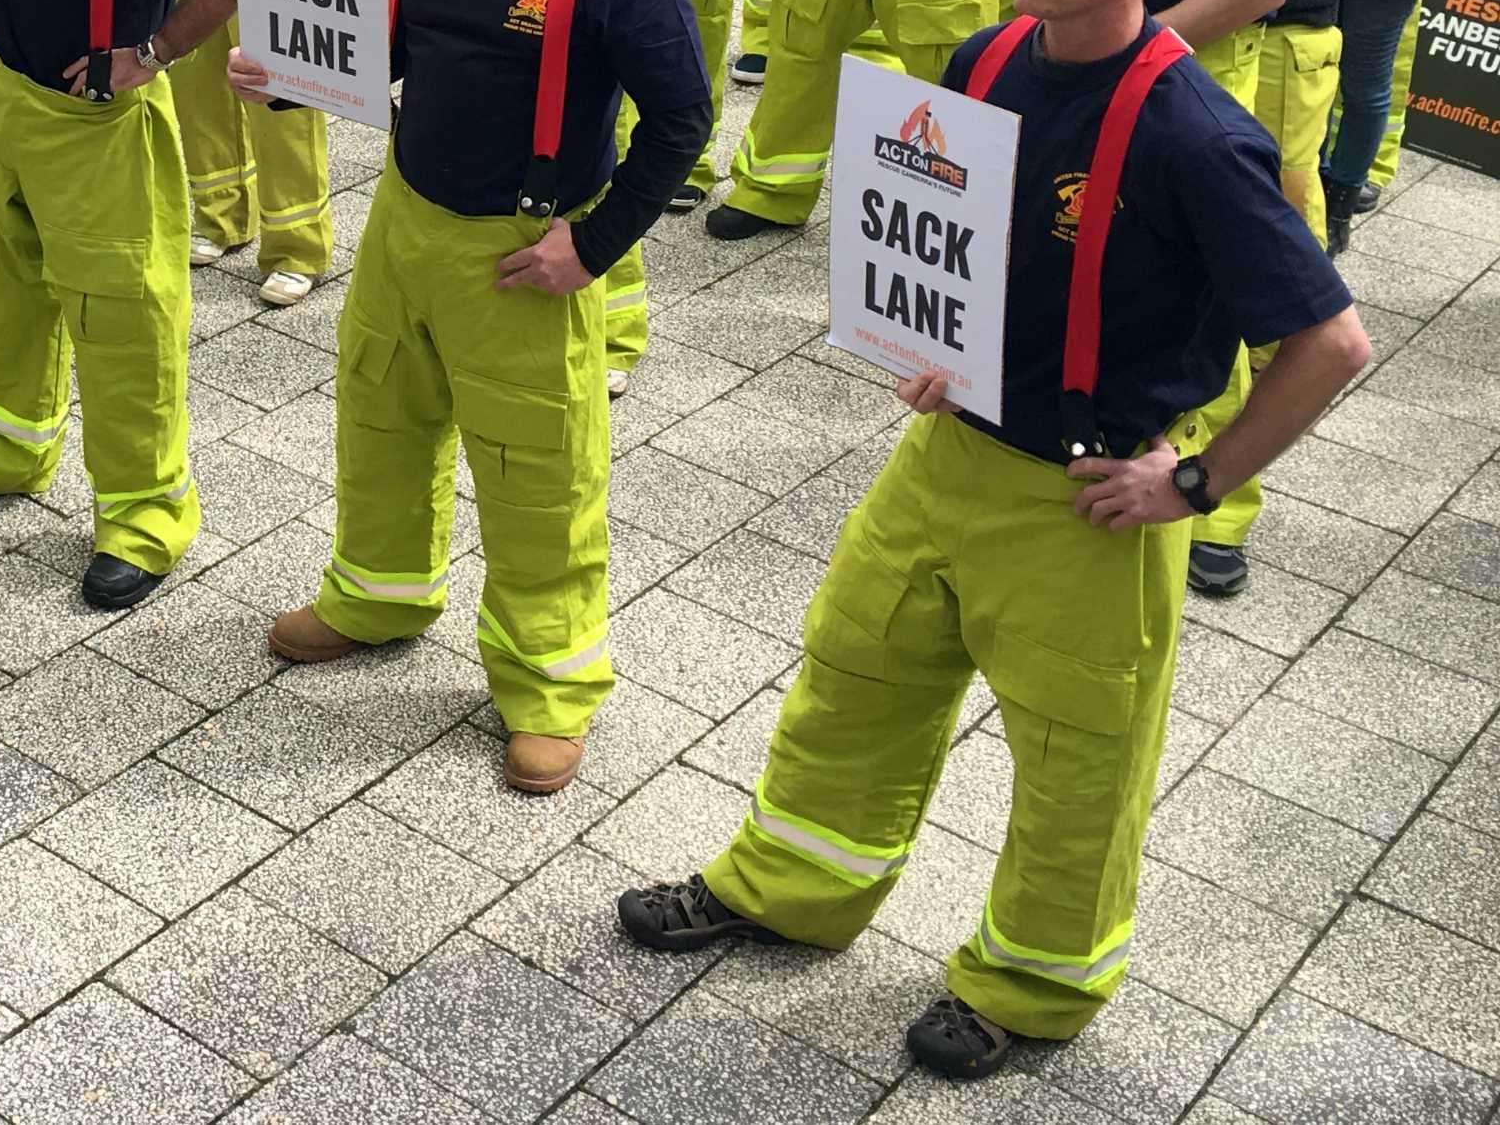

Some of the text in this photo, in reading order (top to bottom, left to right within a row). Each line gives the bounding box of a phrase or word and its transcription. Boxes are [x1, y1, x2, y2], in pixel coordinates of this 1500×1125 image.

[269, 11, 357, 76] LANE
[877, 160, 962, 198] RESCUE CANBERRA'S FUTURE
[878, 141, 965, 187] ACT ON FIRE
[861, 188, 974, 281] SACK
[865, 261, 966, 353] LANE
